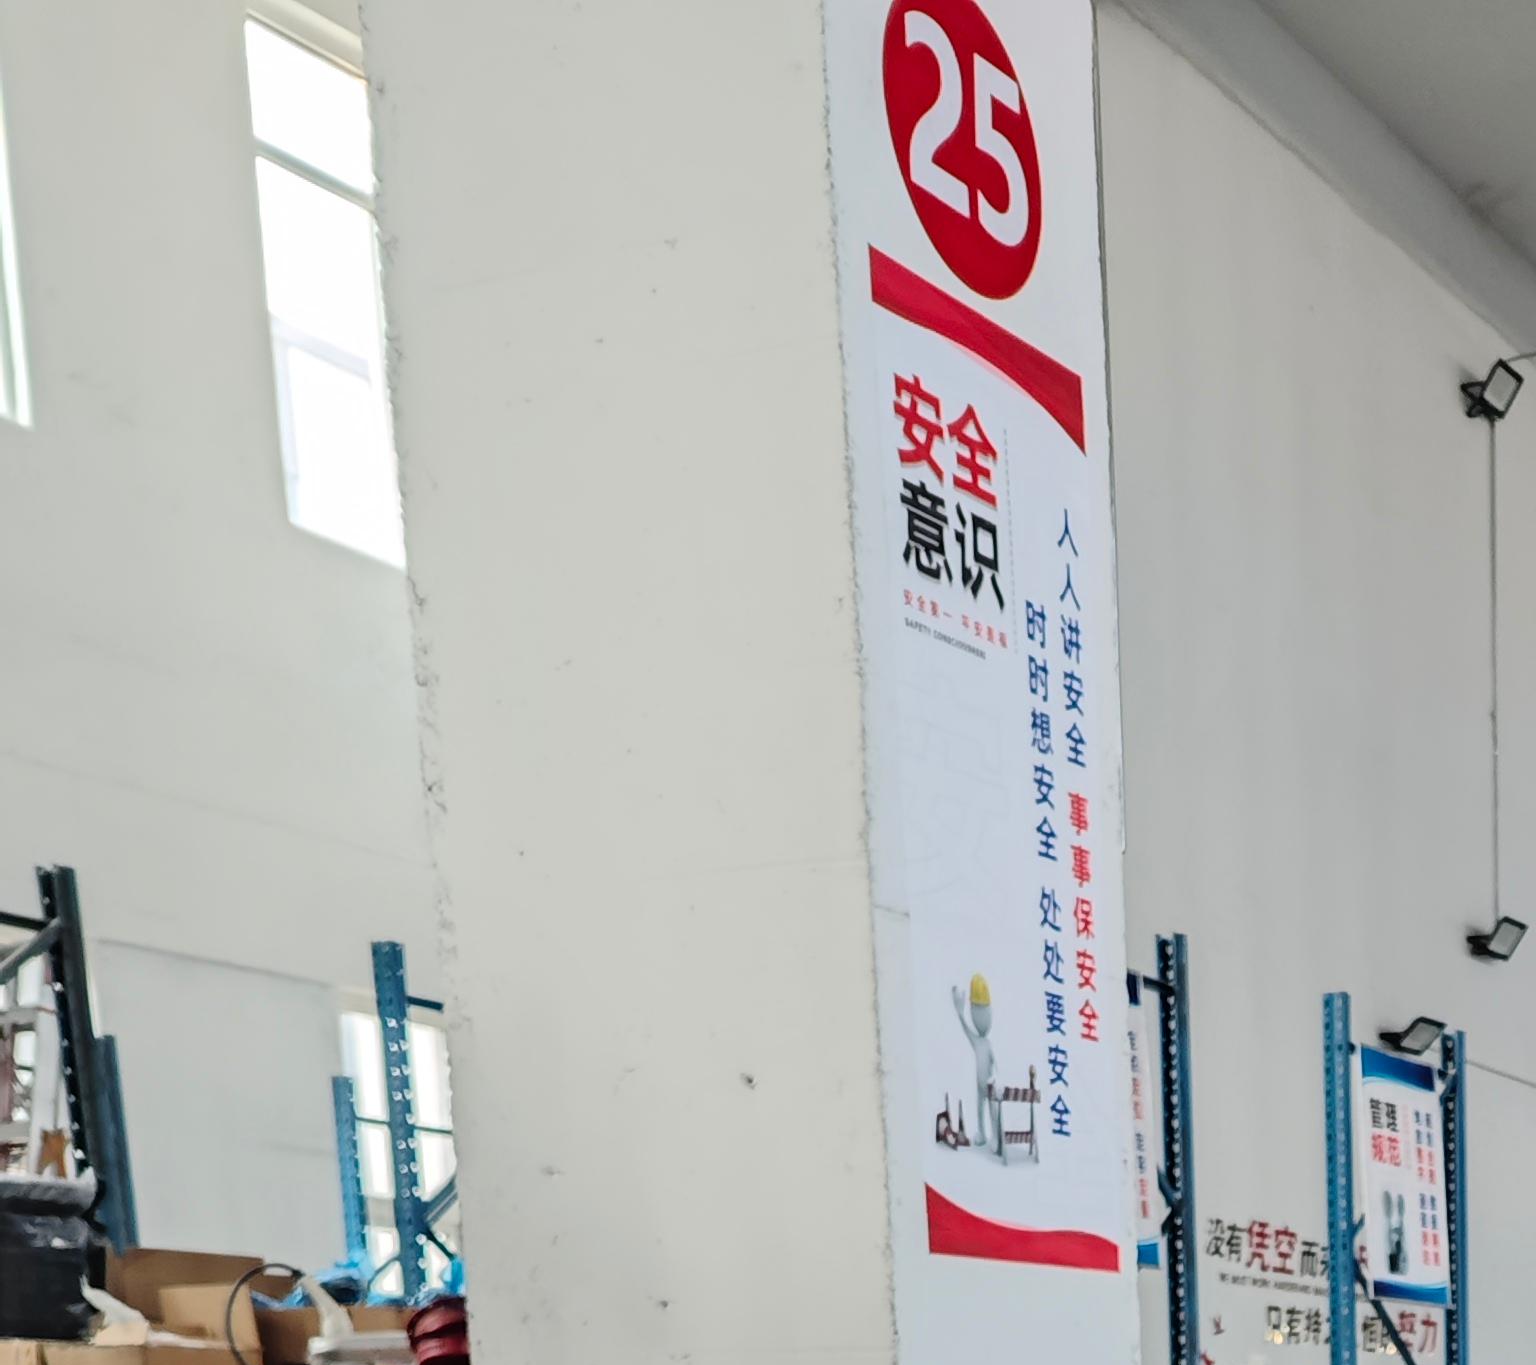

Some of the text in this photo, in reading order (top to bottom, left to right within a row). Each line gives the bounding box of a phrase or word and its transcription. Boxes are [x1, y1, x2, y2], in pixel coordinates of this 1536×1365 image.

[904, 10, 1030, 248] 25
[893, 372, 998, 509] 安全
[900, 478, 1006, 613] 意识
[1025, 599, 1072, 1137] 时时想安全 处处要安全
[1057, 508, 1100, 1043] 人人讲安全 事事保安全
